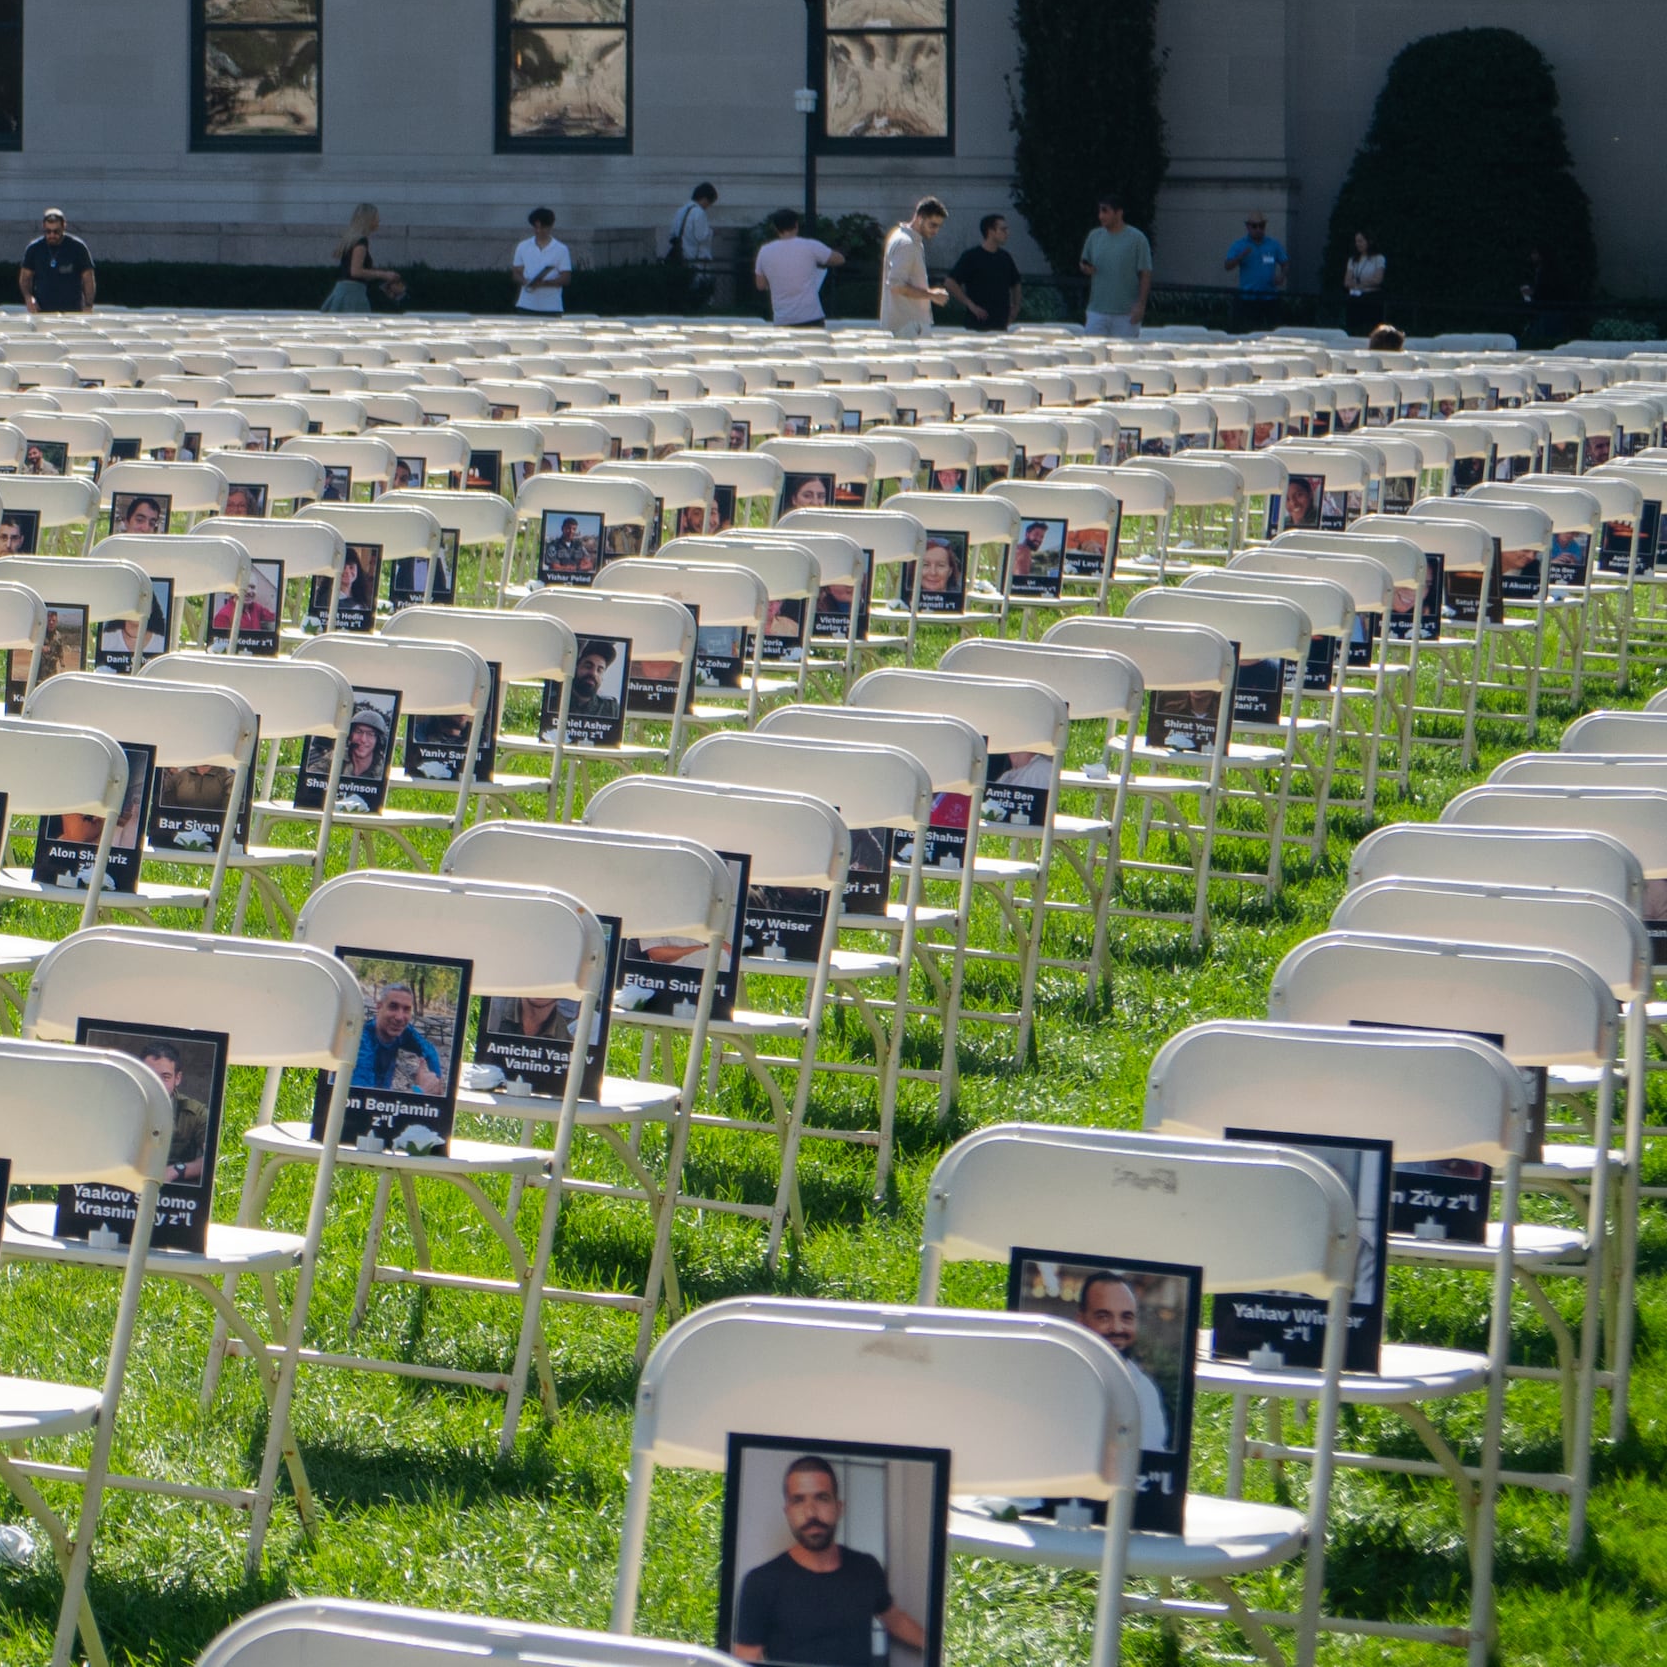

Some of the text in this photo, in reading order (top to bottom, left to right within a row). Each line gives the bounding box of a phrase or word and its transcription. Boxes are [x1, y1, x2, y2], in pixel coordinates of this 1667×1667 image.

[106, 655, 130, 664] Danit
[706, 660, 732, 670] Zohar
[552, 718, 613, 731] Dniel Asher
[1164, 719, 1216, 733] Shirat Yam
[420, 748, 446, 760] Yaniv
[339, 783, 378, 795] evinson
[986, 788, 1035, 803] Amit Ben
[159, 818, 220, 833] Bar Sivan
[925, 831, 966, 845] Shahar
[49, 846, 128, 866] Alon Shariz
[843, 883, 880, 896] gri z"l
[745, 918, 812, 934] oey Weiser
[761, 930, 780, 942] z"l
[668, 979, 702, 994] Snir
[486, 1041, 543, 1060] Amichai
[504, 1056, 551, 1073] Vanino
[365, 1097, 440, 1118] Benjamin
[371, 1114, 394, 1129] z"l
[73, 1184, 198, 1211] Yaakov Slomo
[1409, 1189, 1479, 1212] Ziv z"l
[168, 1210, 193, 1227] z"l
[1233, 1302, 1366, 1329] Yahav Winer
[1282, 1324, 1311, 1342] z"l
[1134, 1471, 1174, 1495] z"l
